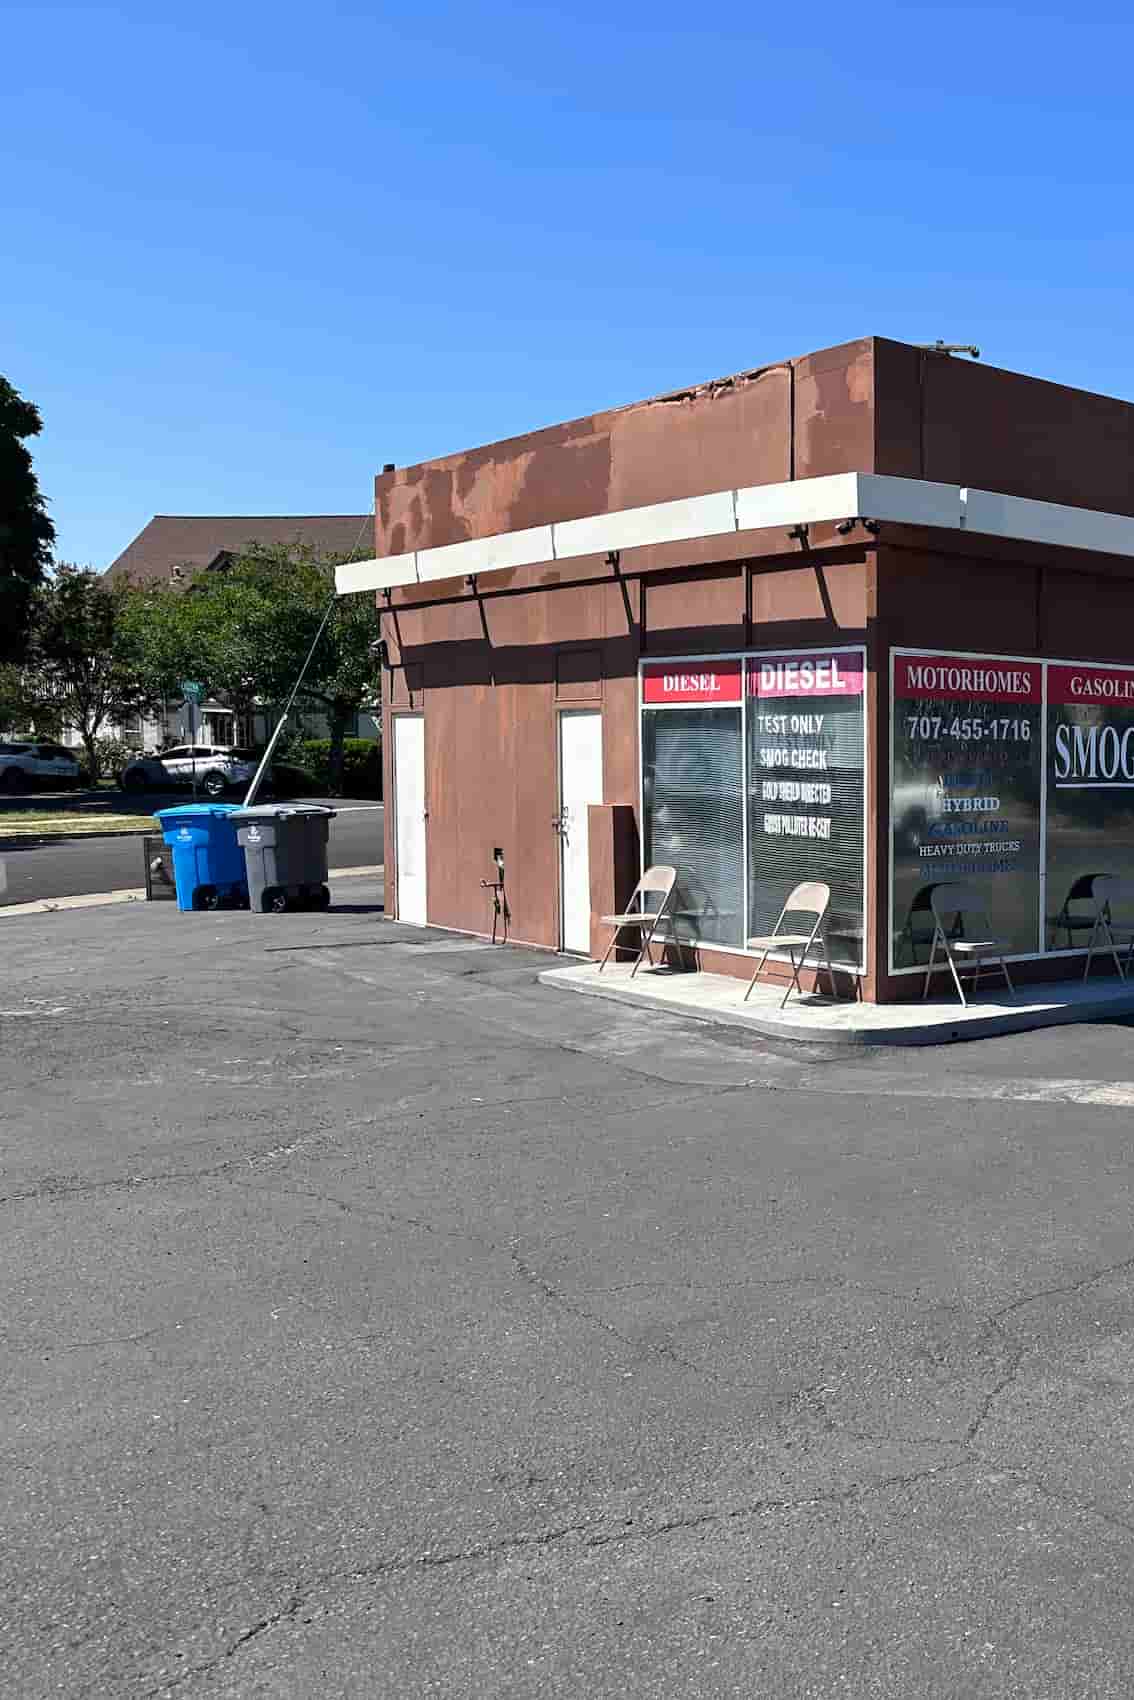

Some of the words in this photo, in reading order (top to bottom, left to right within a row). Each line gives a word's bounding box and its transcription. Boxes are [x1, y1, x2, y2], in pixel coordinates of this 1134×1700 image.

[663, 674, 721, 692] DIESEL
[760, 658, 846, 691] DIESEL
[907, 665, 1032, 694] MOTORHOMES
[757, 714, 787, 735] TEST
[791, 714, 825, 735] ONLY
[908, 716, 1031, 741] 707-455-1716
[791, 749, 828, 770] CHECK
[943, 797, 999, 812] HYBRID
[919, 845, 954, 856] HEAVY
[956, 843, 982, 855] DUTY
[983, 841, 1020, 853] TRUCKS
